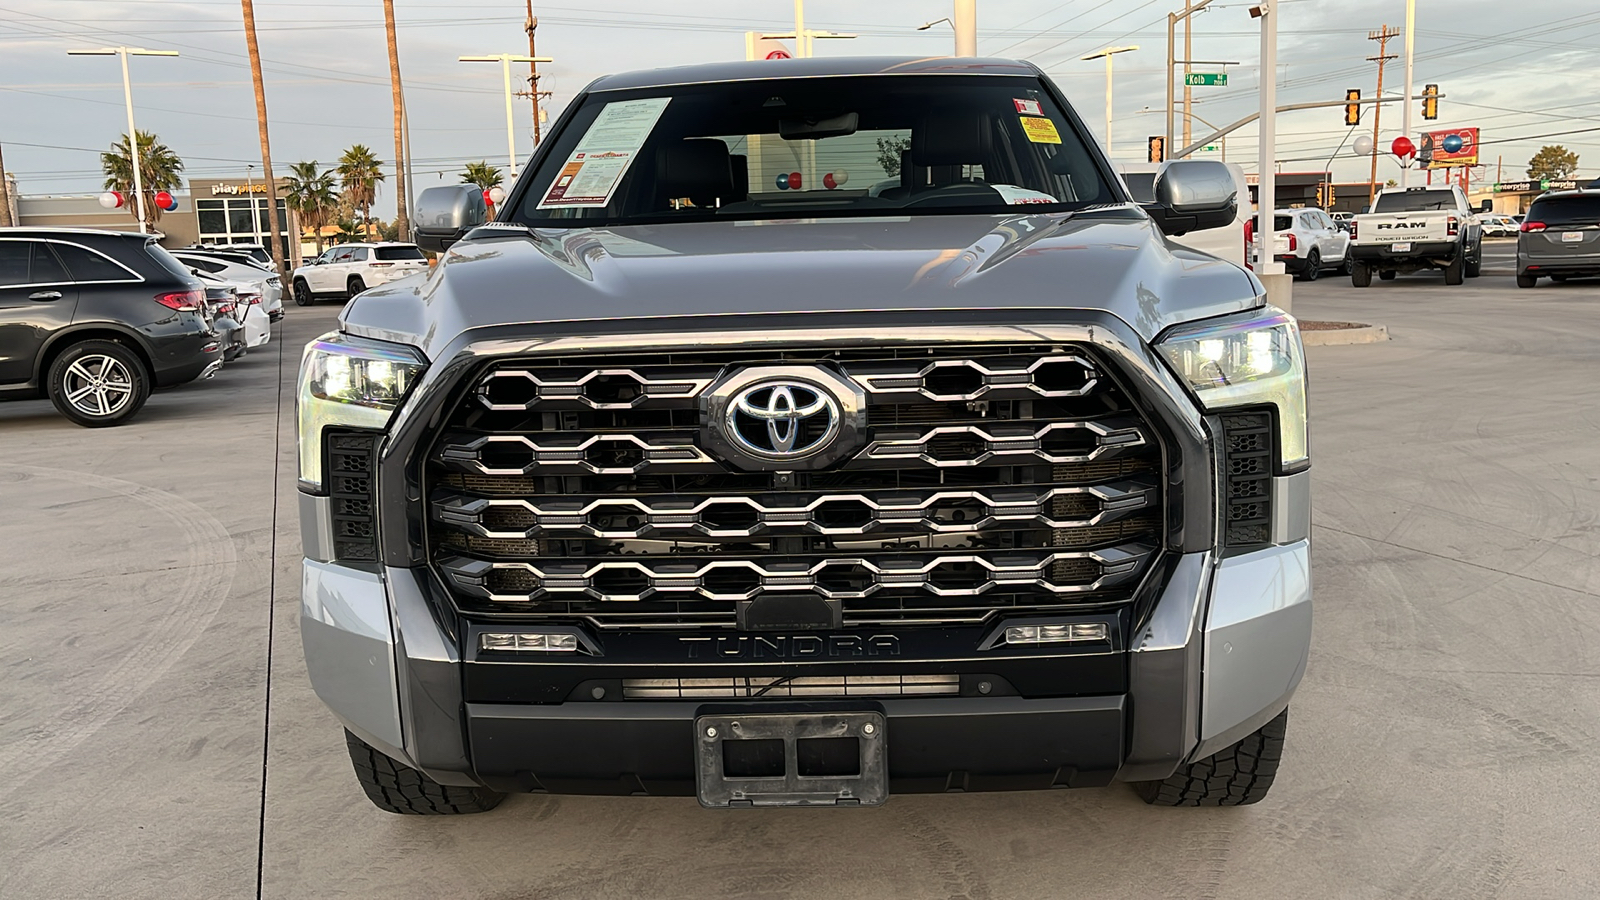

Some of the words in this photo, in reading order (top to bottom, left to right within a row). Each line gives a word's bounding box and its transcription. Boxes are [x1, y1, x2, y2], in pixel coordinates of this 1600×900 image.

[1189, 74, 1206, 85] Kolb
[1494, 182, 1531, 191] enterprise
[1541, 180, 1577, 189] enterprise
[1377, 221, 1427, 230] RAM
[678, 634, 901, 659] TUNDRA
